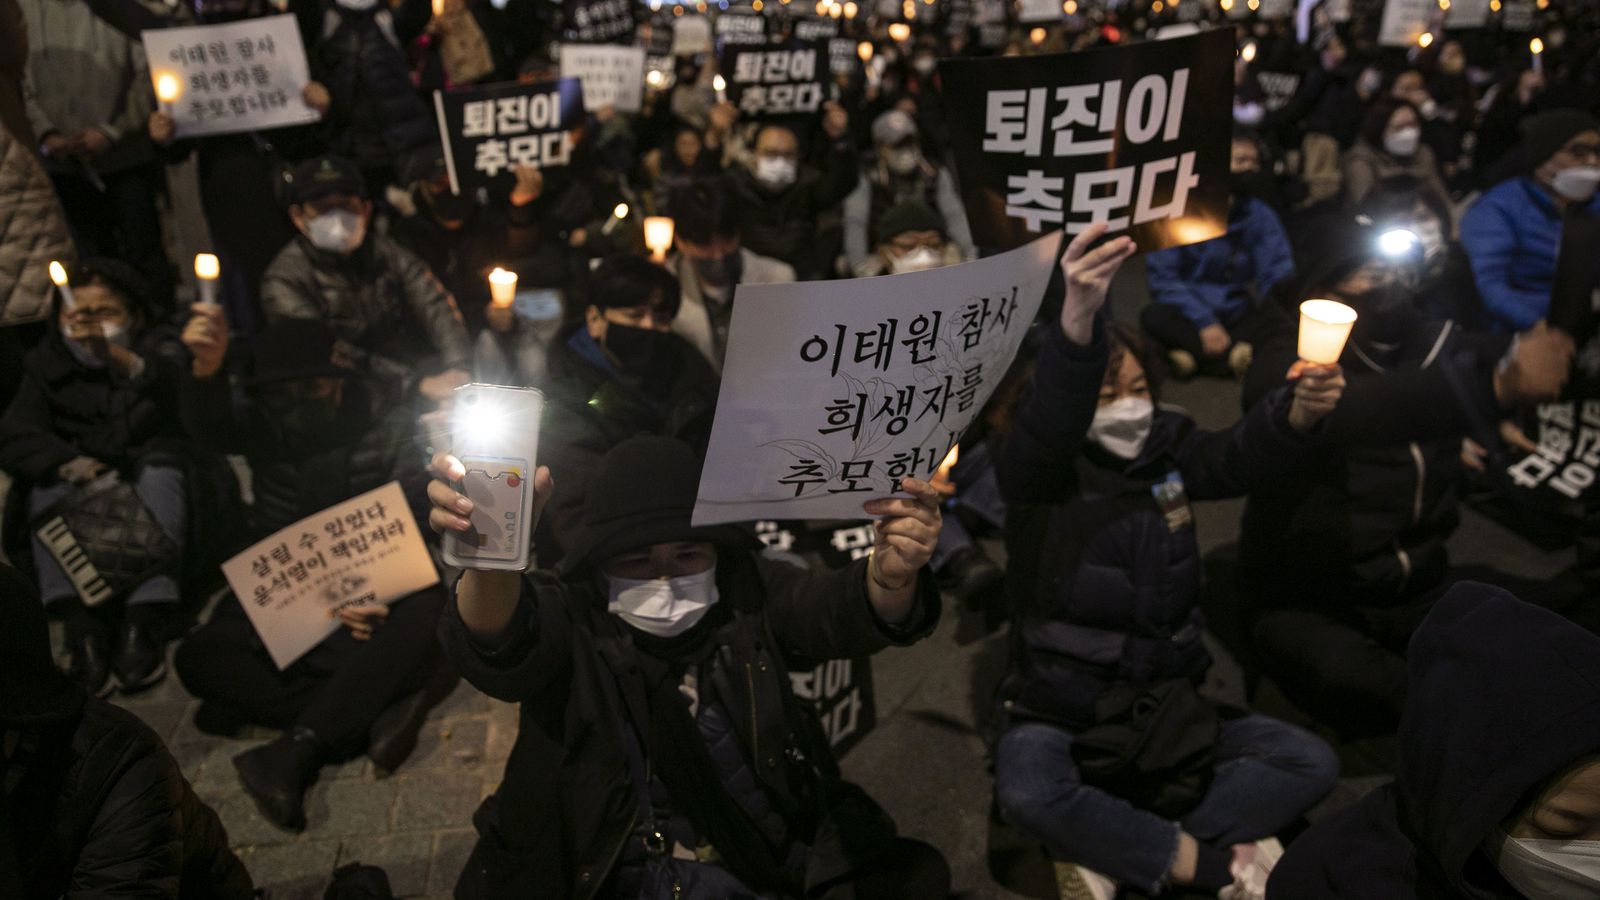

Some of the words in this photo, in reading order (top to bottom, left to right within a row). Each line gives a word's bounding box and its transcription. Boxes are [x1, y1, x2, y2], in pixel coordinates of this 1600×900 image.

[169, 41, 229, 67] 이태원
[733, 48, 816, 83] 퇴진이
[190, 64, 270, 92] 희생자를
[741, 82, 823, 116] 추모다
[189, 88, 288, 121] 추모합니다
[462, 91, 560, 138] 퇴진이
[982, 68, 1190, 157] 퇴진이
[475, 130, 576, 177] 추모다
[1005, 151, 1200, 236] 추모다
[800, 310, 942, 378] 이태원
[956, 285, 1018, 352] 참사
[818, 363, 983, 442] 희생자를
[252, 542, 292, 578] 살릴
[299, 531, 319, 550] 수
[324, 500, 386, 539] 있었다
[253, 550, 328, 607] 윤석열이
[329, 517, 405, 558] 책임져라
